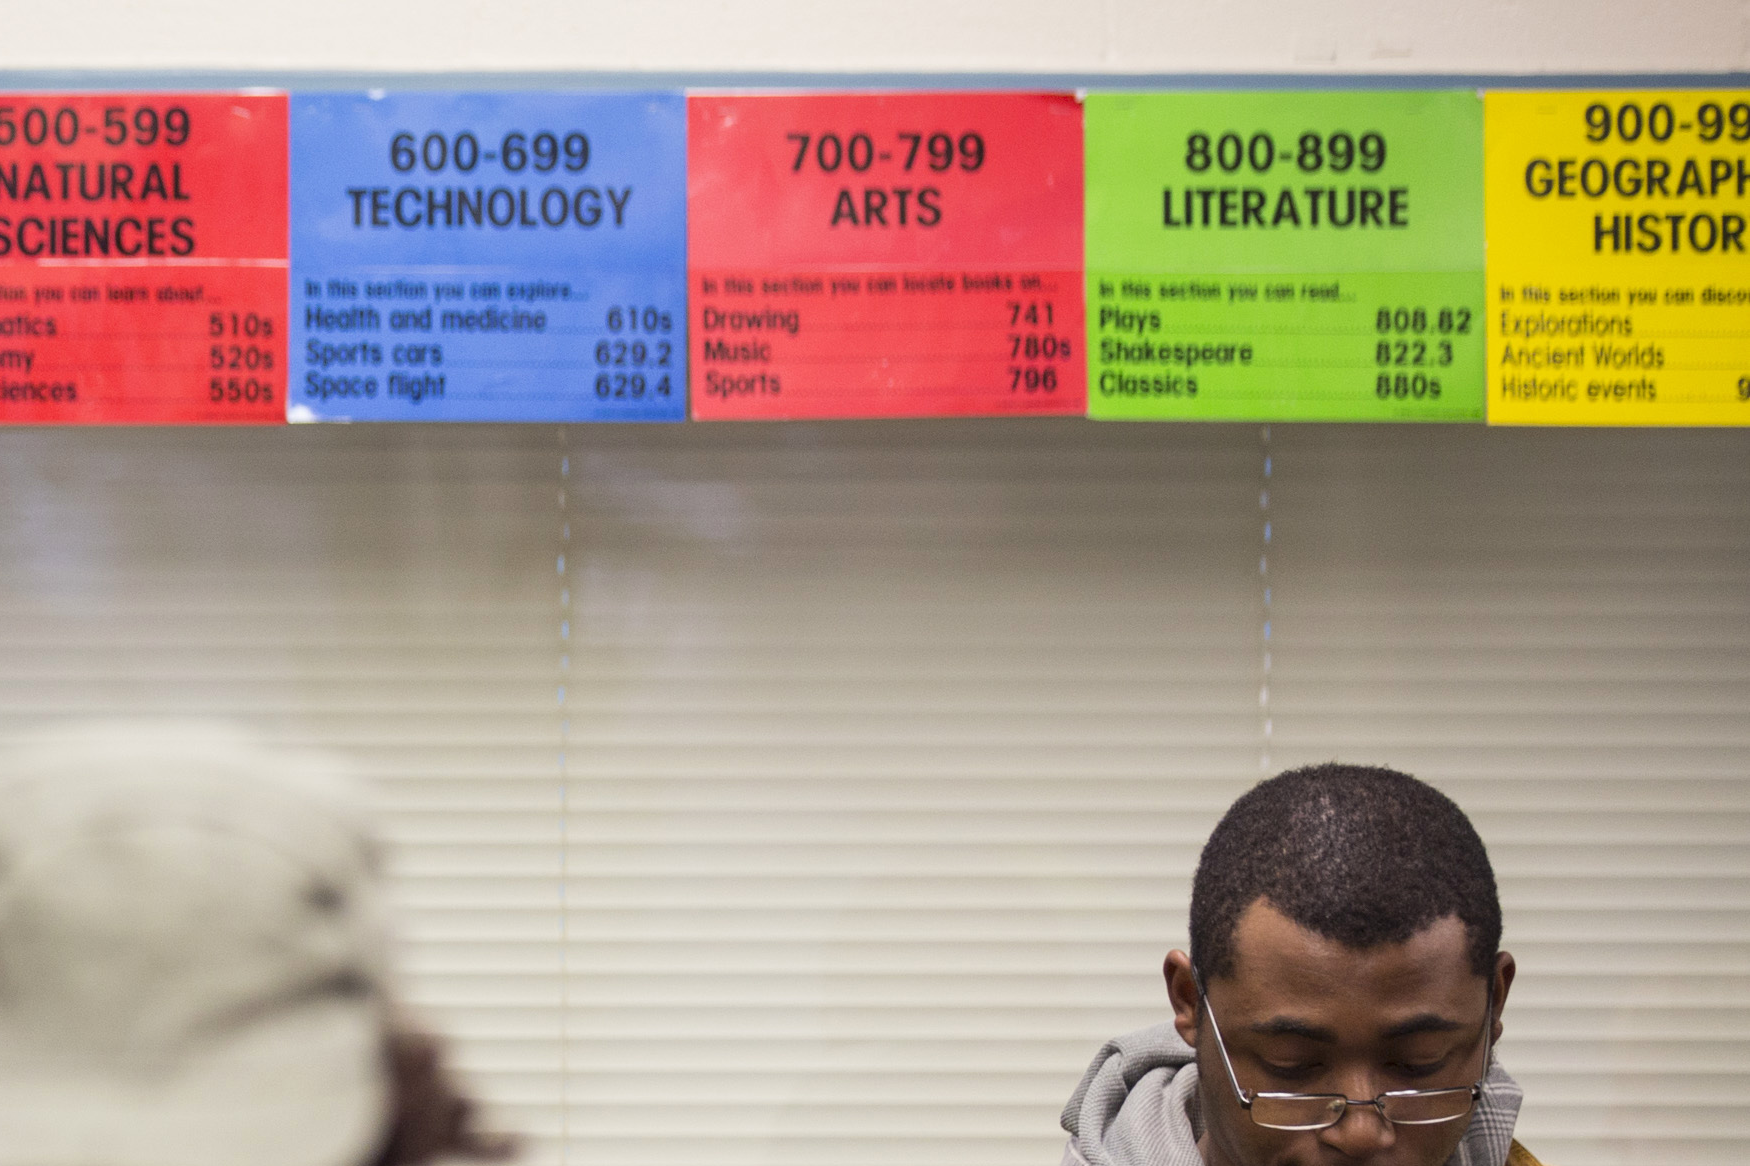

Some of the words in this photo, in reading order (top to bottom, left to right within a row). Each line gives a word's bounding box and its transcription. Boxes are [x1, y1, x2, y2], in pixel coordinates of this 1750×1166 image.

[390, 130, 591, 173] 600-699
[787, 131, 986, 173] 700-799
[1184, 131, 1386, 173] 800-899
[347, 186, 633, 228] TECHNOLOGY
[831, 186, 943, 228] ARTS
[1162, 186, 1409, 228] LITERATURE
[1594, 212, 1747, 253] HISTOR
[209, 312, 273, 338] 510s
[304, 307, 380, 333] Health
[390, 307, 432, 333] and
[441, 307, 546, 333] medicine
[607, 307, 672, 333] 610s
[703, 307, 800, 335] Drawing
[1009, 302, 1054, 325] 741
[1100, 307, 1161, 336] Plays
[1500, 311, 1633, 338] Explorations
[209, 345, 273, 371] 520s
[305, 339, 382, 368] Sports
[393, 343, 443, 366] cars
[595, 340, 672, 367] 629.2
[703, 339, 770, 363] Music
[1009, 334, 1071, 358] 780s
[1100, 339, 1252, 368] Shakespeare
[1375, 340, 1452, 367] 822.3
[1501, 344, 1585, 367] Ancient
[1594, 343, 1664, 368] Worlds
[209, 378, 273, 404] 550s
[305, 371, 377, 400] Space
[388, 371, 446, 402] flight
[595, 373, 672, 399] 629.4
[705, 371, 781, 398] Sports
[1009, 368, 1057, 392] 796
[1100, 370, 1198, 397] Classics
[1375, 372, 1441, 399] 880s
[1501, 375, 1578, 401] Historic
[1587, 376, 1656, 401] events
